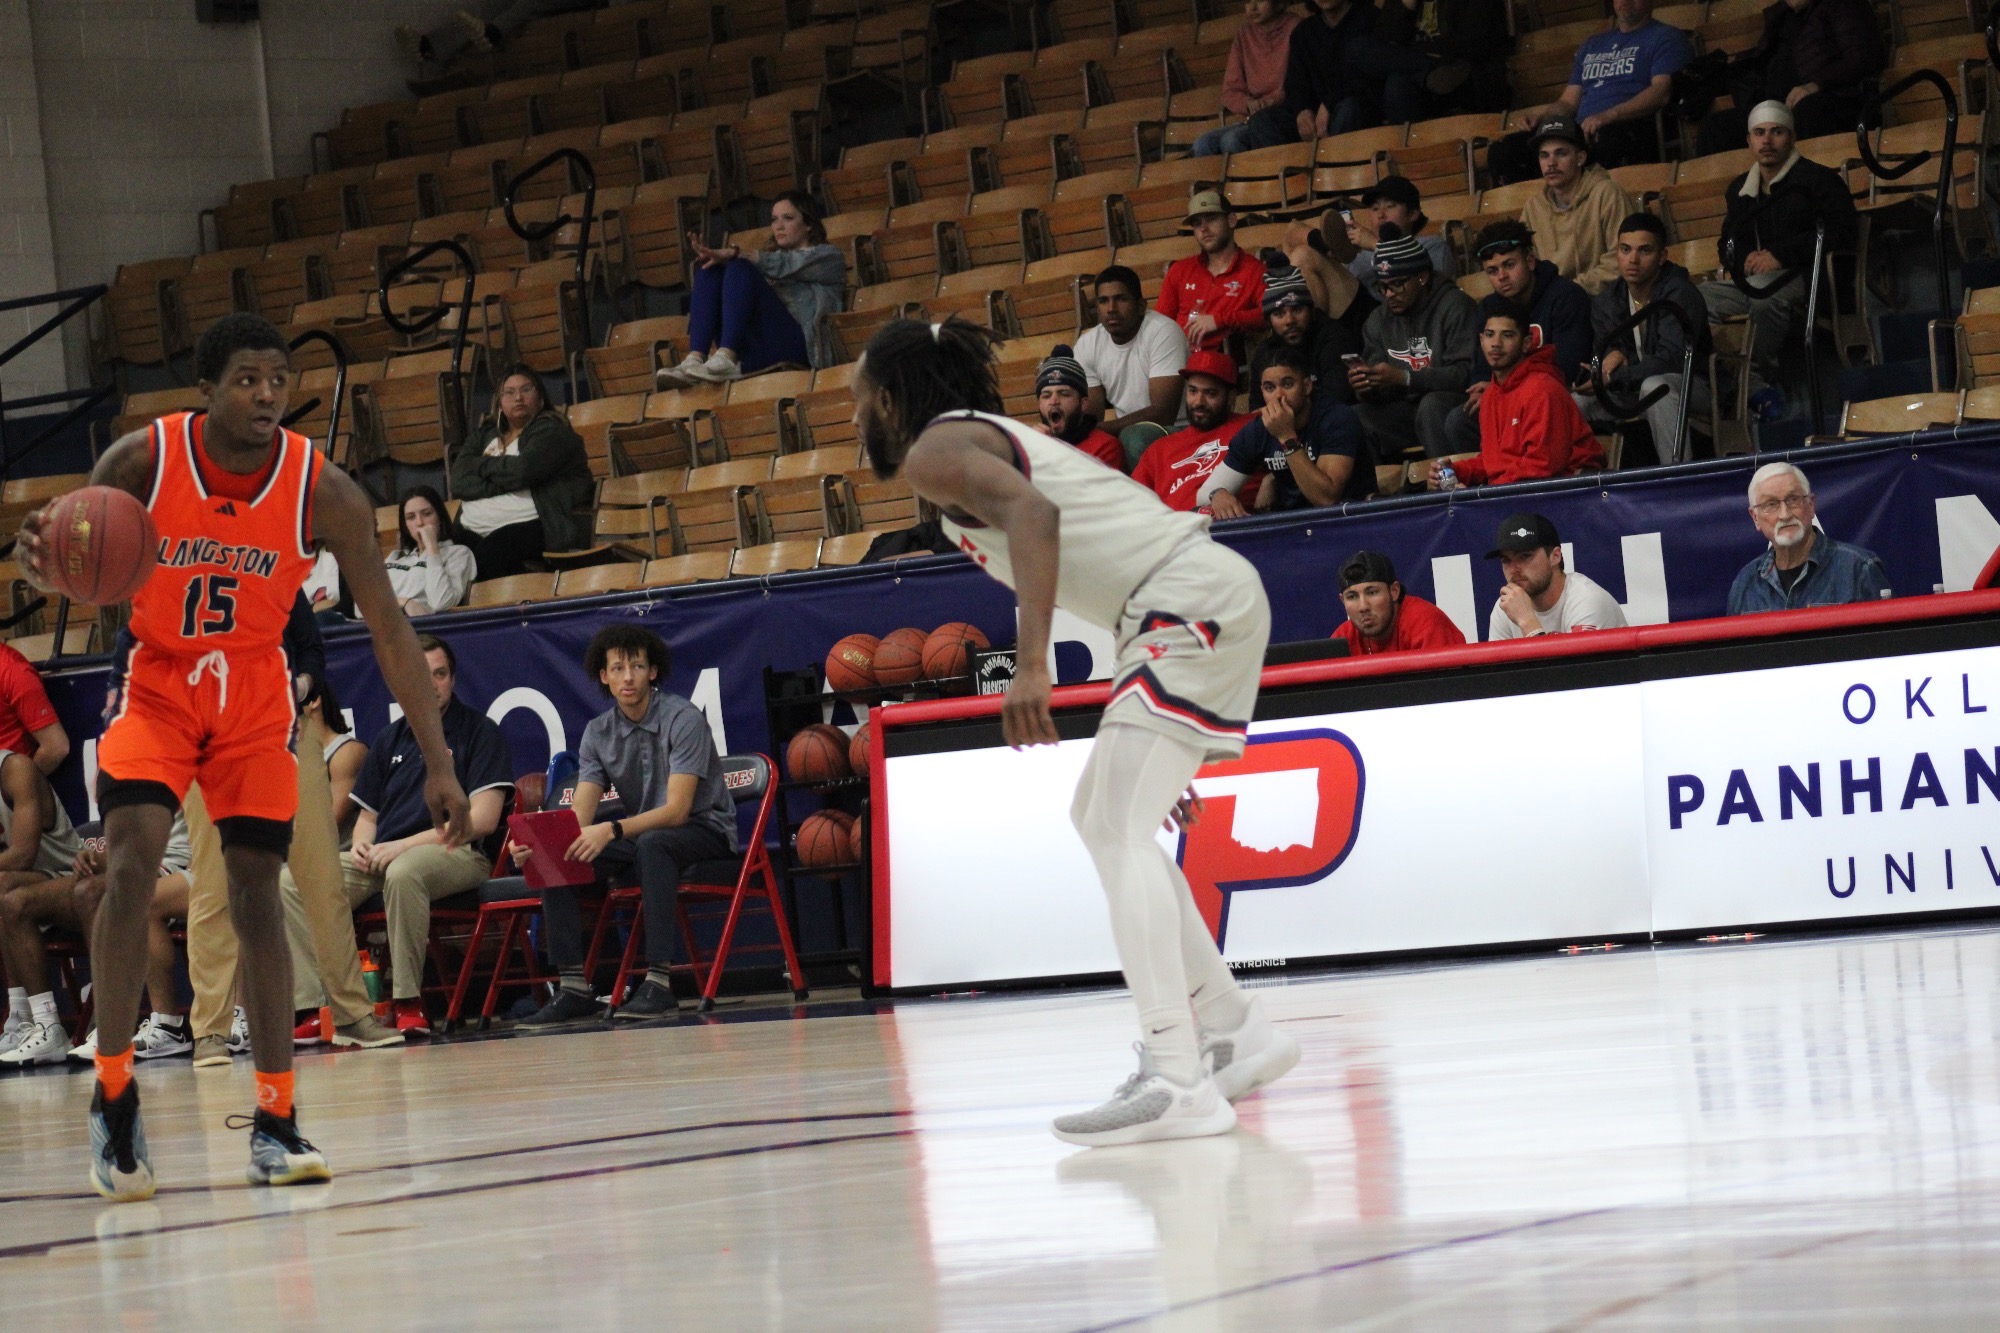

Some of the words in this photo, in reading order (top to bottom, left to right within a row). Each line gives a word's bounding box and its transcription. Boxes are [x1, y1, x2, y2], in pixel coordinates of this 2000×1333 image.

[157, 537, 280, 578] LANGSTON
[181, 573, 240, 637] 15
[981, 655, 1017, 677] PANHANDLE
[1842, 673, 1987, 725] OKL
[1227, 958, 1287, 970] AKTRONICS
